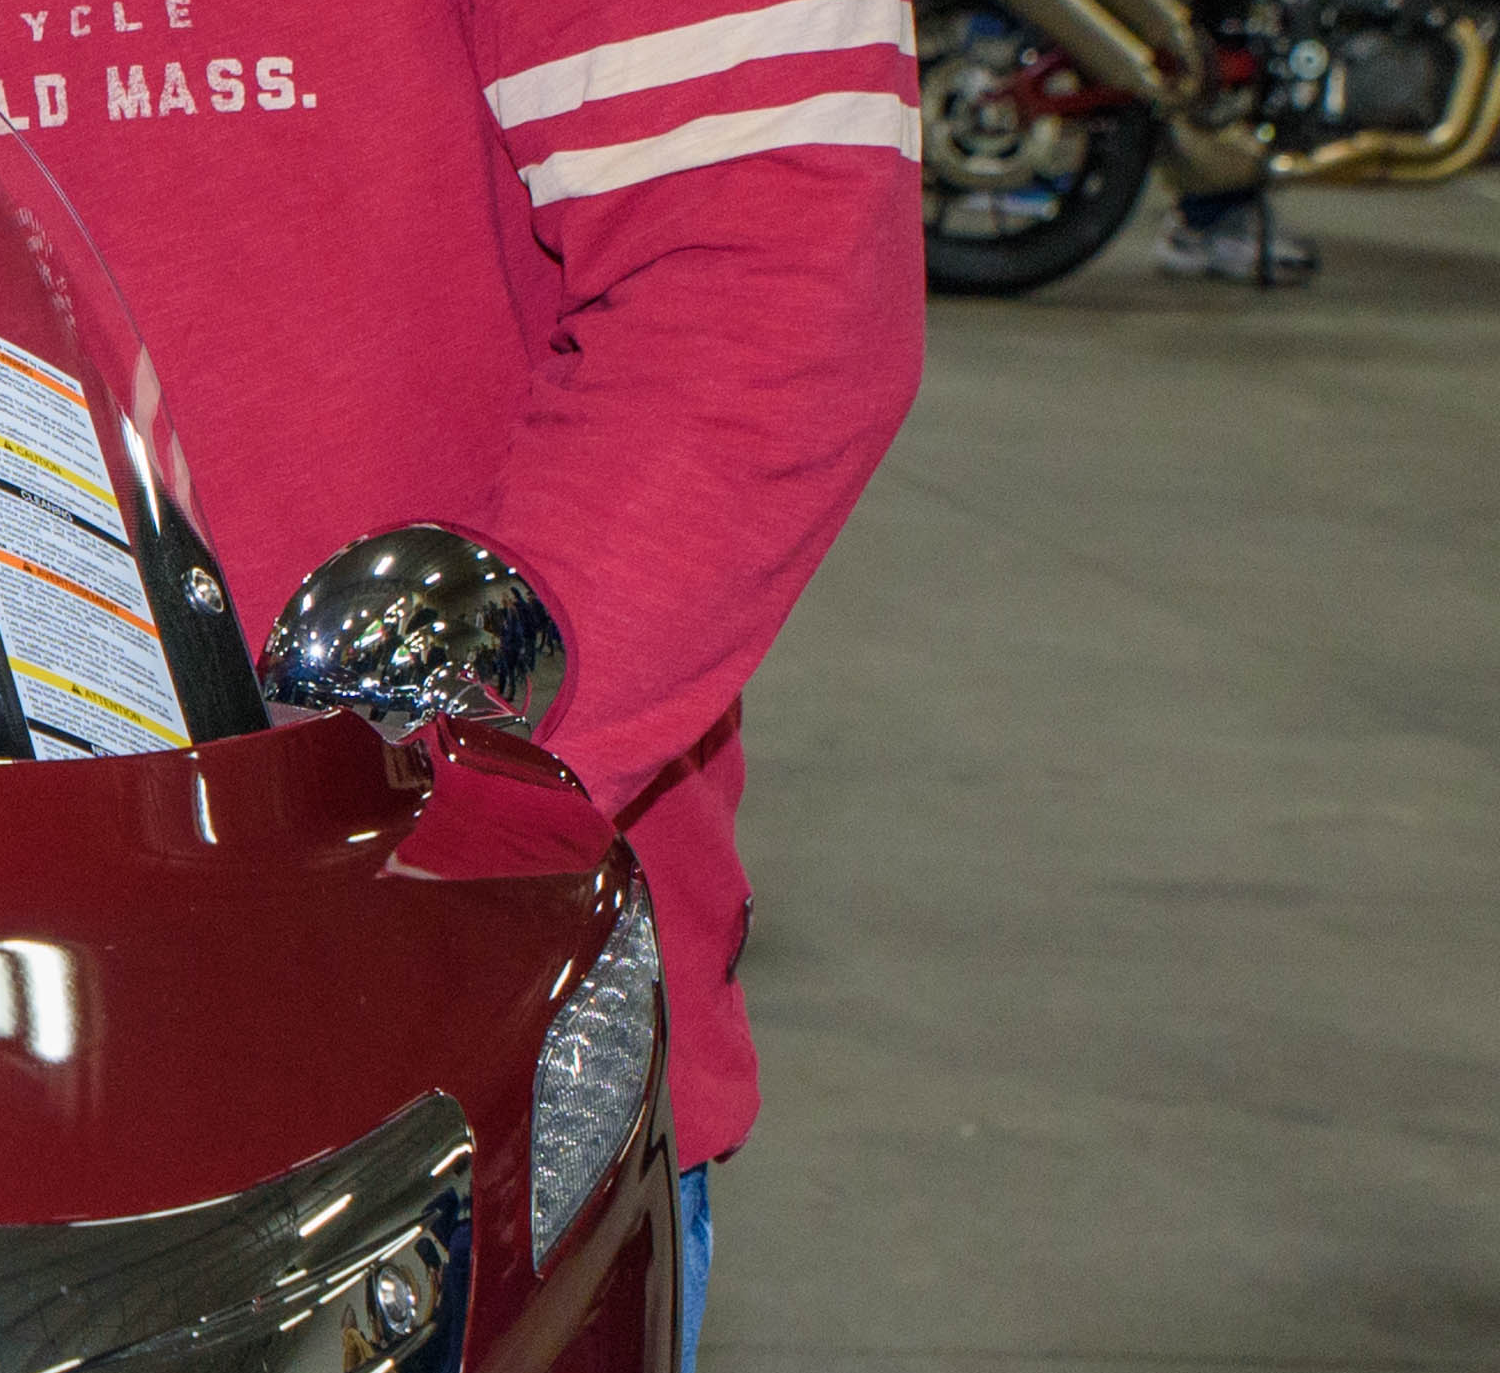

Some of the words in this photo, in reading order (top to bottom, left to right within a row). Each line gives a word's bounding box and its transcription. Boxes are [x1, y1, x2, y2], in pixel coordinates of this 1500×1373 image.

[106, 55, 318, 122] MASS.
[16, 445, 62, 476] CAUTION
[20, 489, 74, 523] CLEANING
[84, 686, 142, 724] ATTENTION
